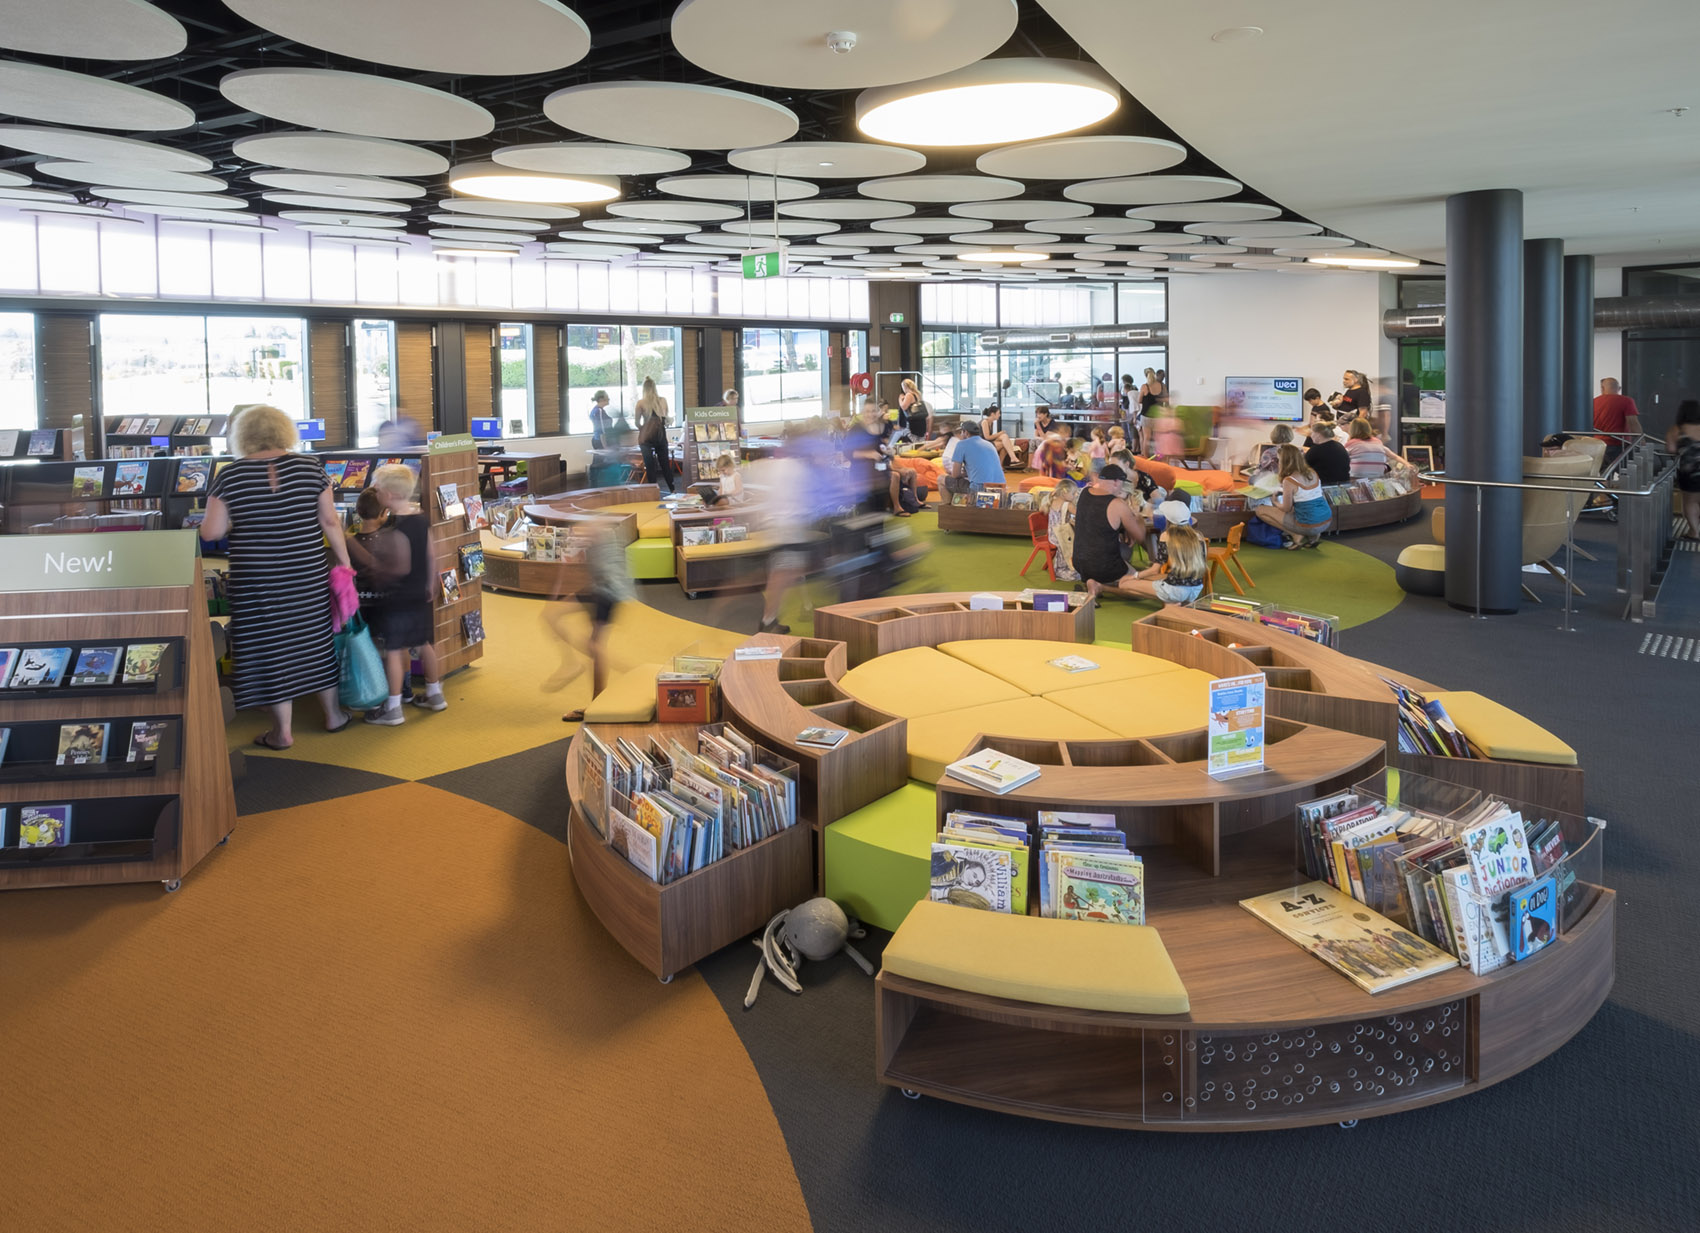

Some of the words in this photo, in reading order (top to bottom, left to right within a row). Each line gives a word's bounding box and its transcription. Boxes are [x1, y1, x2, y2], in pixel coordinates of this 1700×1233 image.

[1275, 381, 1297, 389] wea
[694, 410, 708, 418] Kids
[708, 410, 730, 418] Comics
[434, 441, 457, 449] Children's
[457, 439, 473, 447] Fiction
[44, 550, 114, 575] New!
[1069, 868, 1092, 878] Mapping
[1480, 855, 1528, 882] JUNIOR
[1280, 893, 1326, 912] A-Z
[1292, 904, 1336, 919] CONVICTS
